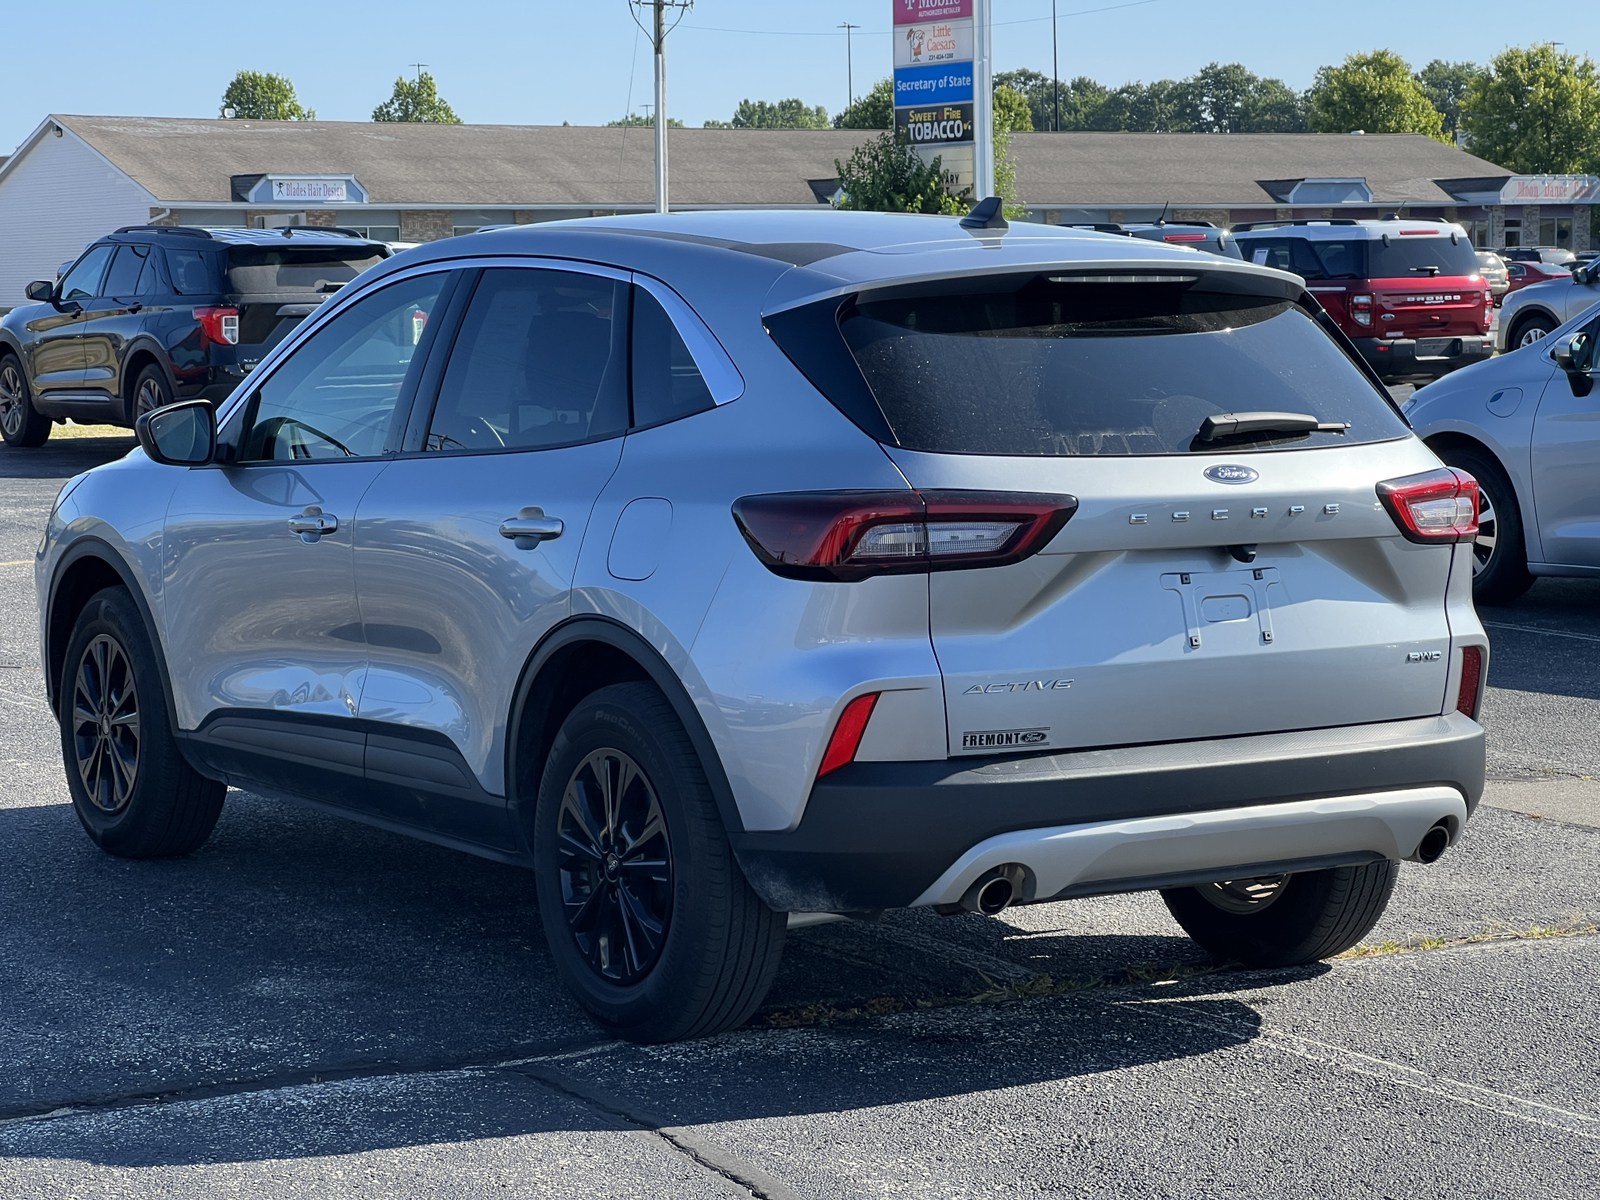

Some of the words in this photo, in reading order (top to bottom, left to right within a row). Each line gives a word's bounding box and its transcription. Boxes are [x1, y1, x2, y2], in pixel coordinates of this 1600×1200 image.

[932, 25, 951, 38] Little
[926, 39, 956, 52] Caesars
[897, 80, 937, 92] Secretary
[938, 76, 948, 88] of
[949, 75, 971, 87] State
[908, 120, 963, 141] TOBACCO
[286, 183, 307, 197] Blades
[308, 183, 321, 197] Hair
[323, 183, 344, 198] Design
[1517, 181, 1539, 198] Moon
[1544, 183, 1568, 198] Dance
[1129, 503, 1340, 525] ESCAPE
[962, 678, 1075, 695] ACTIVE
[963, 732, 1020, 746] FREMONT
